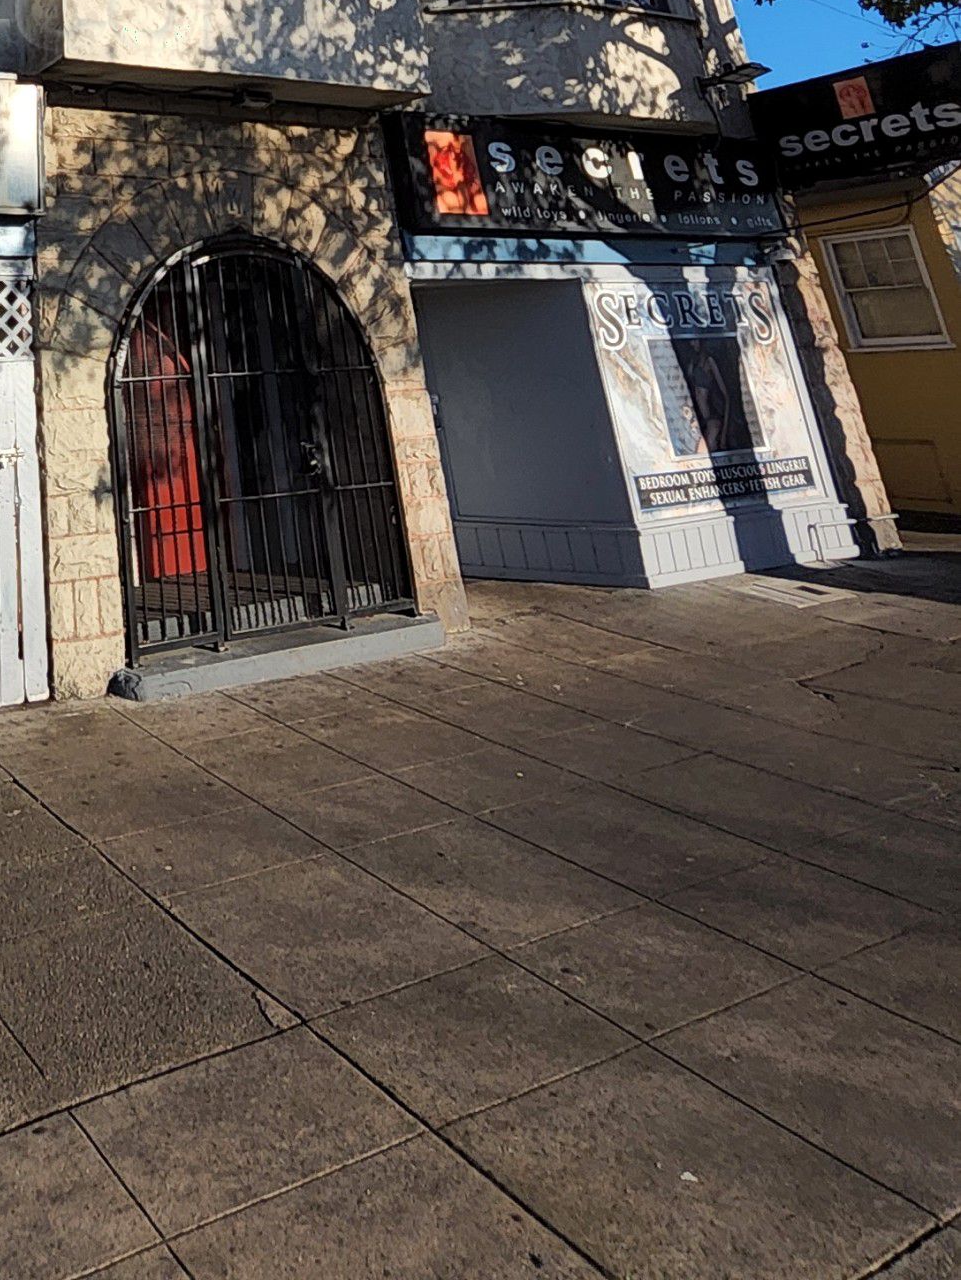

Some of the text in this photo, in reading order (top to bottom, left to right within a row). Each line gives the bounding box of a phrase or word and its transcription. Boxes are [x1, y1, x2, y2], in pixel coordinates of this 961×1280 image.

[778, 100, 961, 157] secrets
[487, 141, 760, 187] secrets
[494, 181, 767, 206] AWAKEN THE PASSION
[501, 205, 531, 218] wild
[595, 291, 774, 348] SECRETS
[639, 473, 691, 490] BEDROOM
[692, 469, 717, 484] TOYS
[766, 459, 808, 475] LINGERIE
[650, 473, 807, 506] SEXUAL ENHANCERS FETISH GEAR
